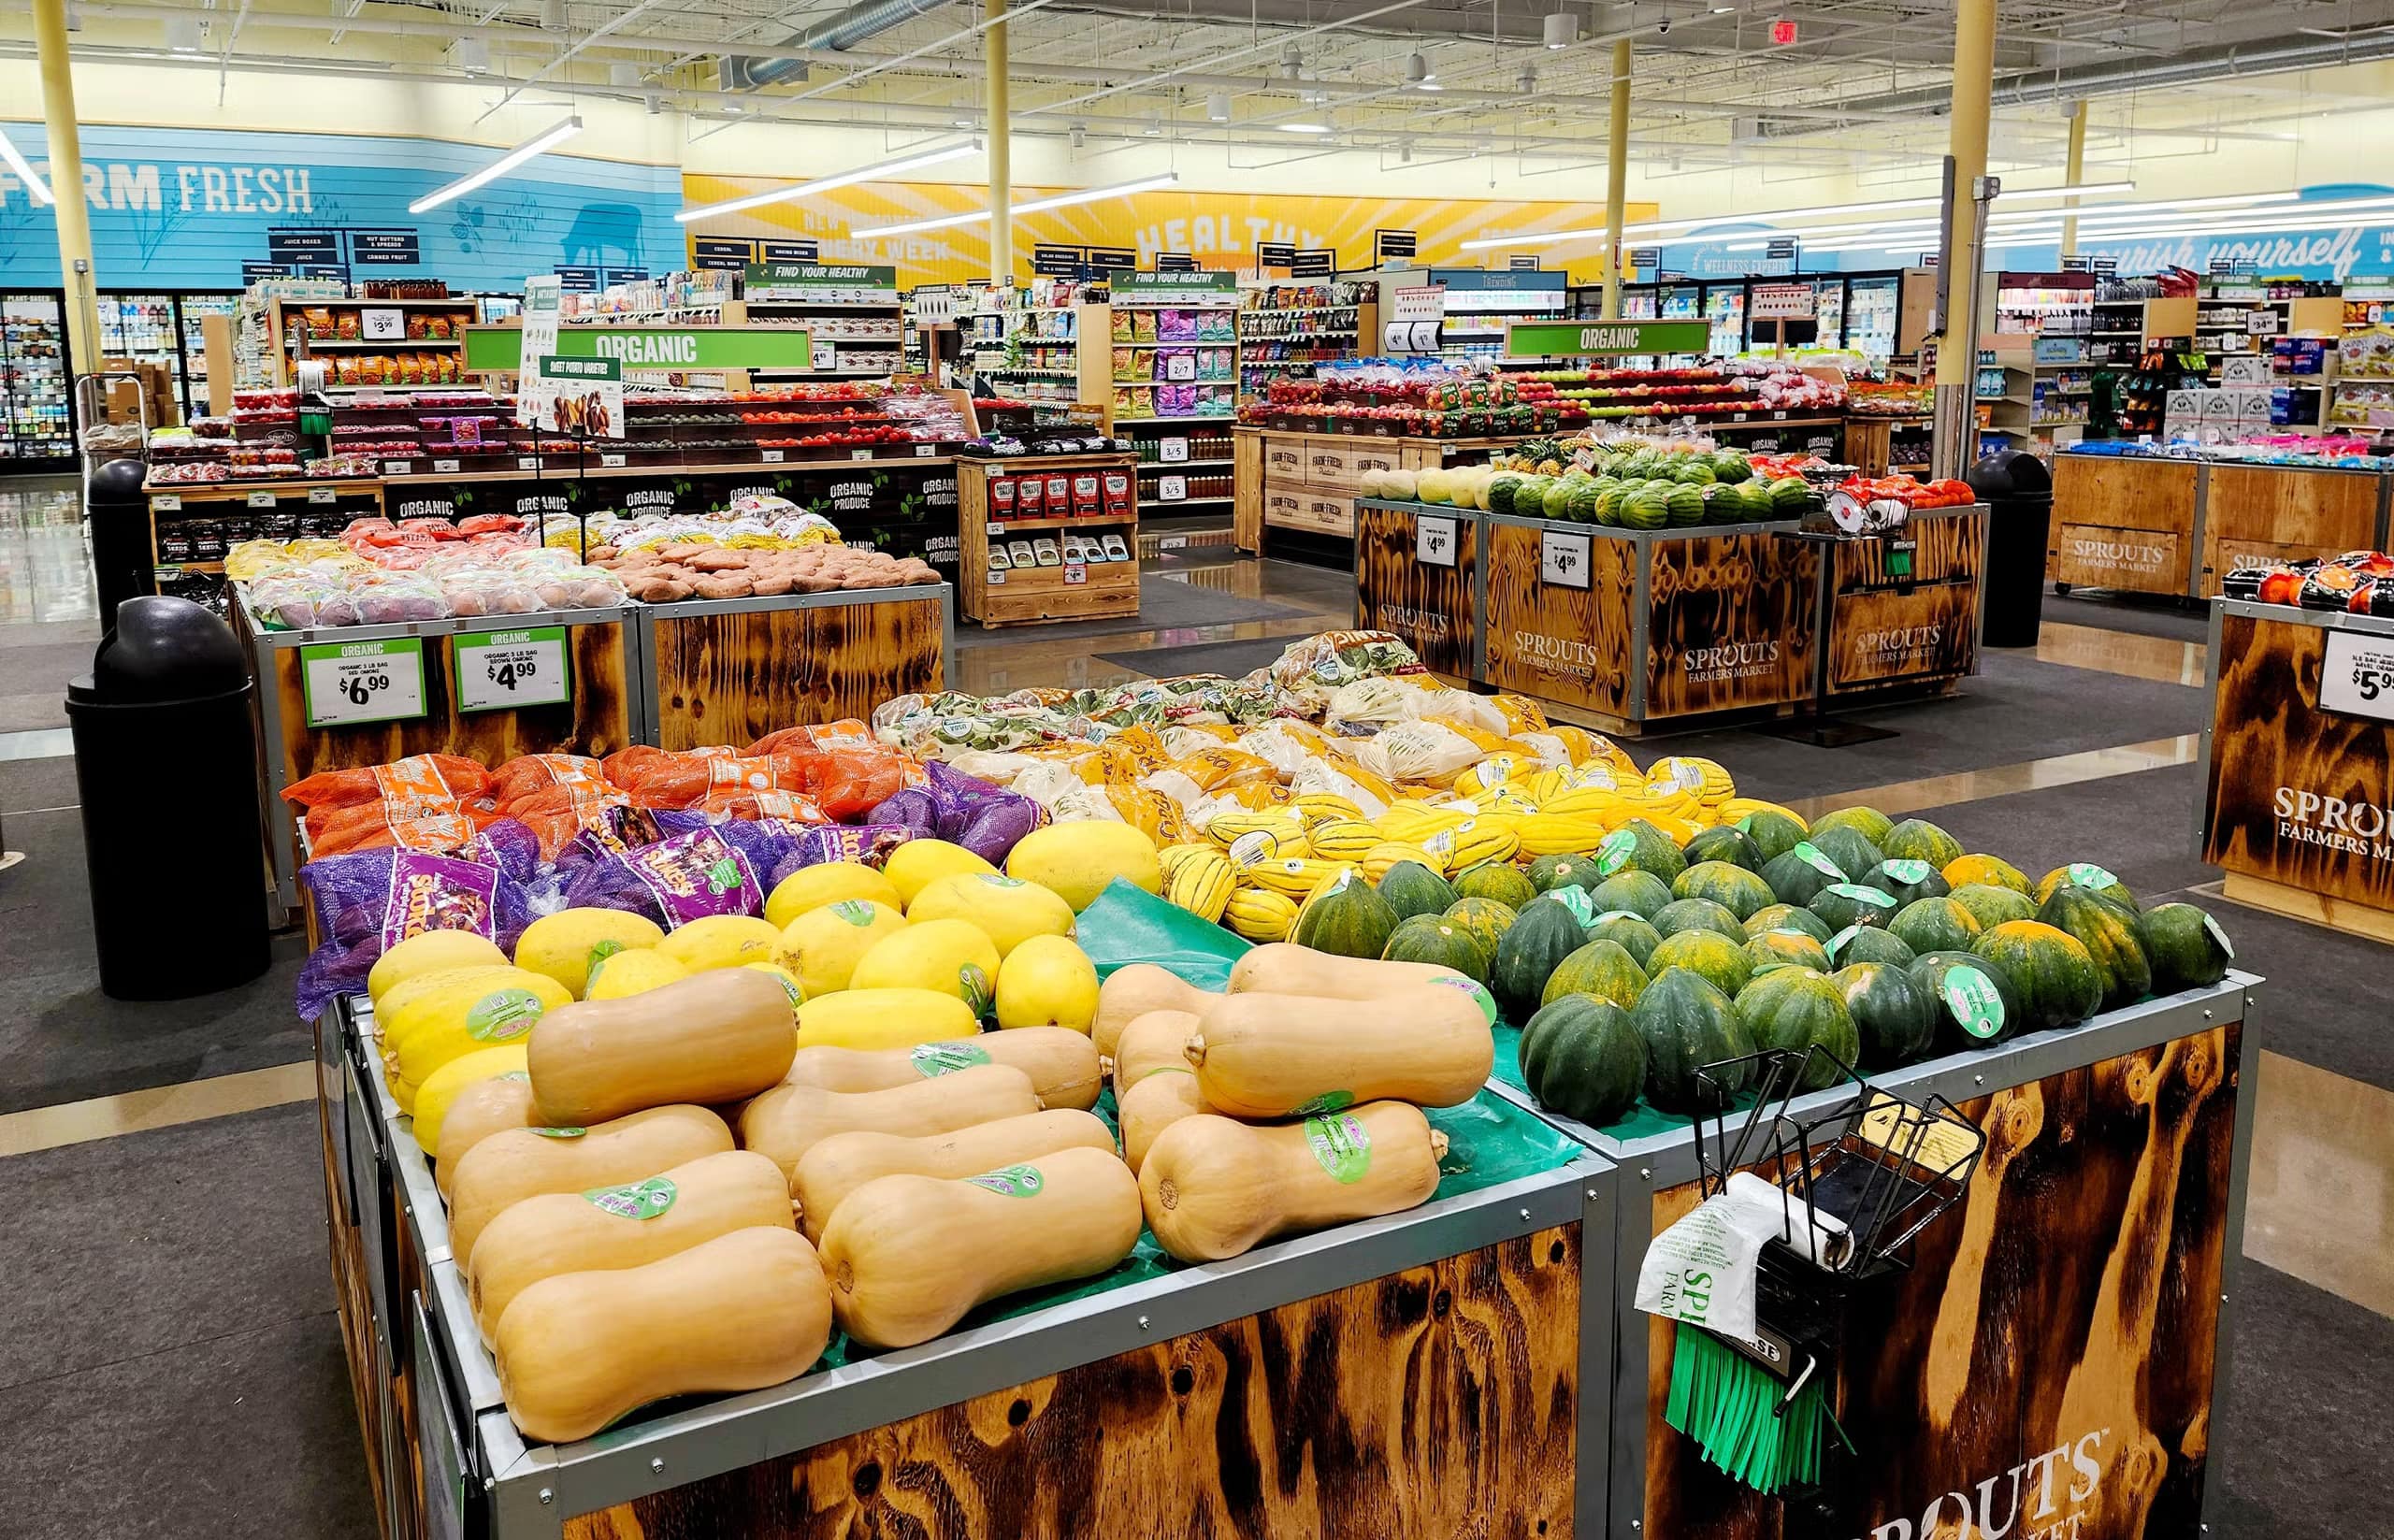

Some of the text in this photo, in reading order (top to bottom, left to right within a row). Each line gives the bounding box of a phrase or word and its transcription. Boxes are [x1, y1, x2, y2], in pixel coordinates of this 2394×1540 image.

[177, 166, 313, 214] FRESH
[887, 238, 950, 261] WEEK
[2078, 237, 2197, 273] urish
[774, 266, 870, 280] FIND YOUR HEALTHY
[1135, 272, 1155, 283] FIND
[1157, 273, 1178, 283] YOUR
[1179, 273, 1215, 284] HEALTHY
[1580, 327, 1640, 350] ORGANIC
[595, 335, 697, 363] ORGANIC
[550, 361, 609, 375] SWEET POTATO VARIETIES
[1174, 366, 1189, 374] 2/7
[1752, 439, 1779, 451] ORGANIC
[1807, 437, 1834, 449] ORGANIC
[1166, 447, 1181, 456] 3/5
[1272, 452, 1298, 466] FARM-FRESH
[1312, 455, 1343, 470] FARM-FRESH
[1357, 459, 1391, 472] FARM-FRESH
[830, 482, 873, 498] ORGANIC
[1165, 485, 1180, 495] 3/5
[516, 496, 569, 513] ORGANIC
[627, 490, 675, 507] ORGANIC
[834, 498, 871, 511] PRODUCE
[927, 493, 959, 506] PRODUC
[1271, 497, 1299, 511] FARM-FRESH
[399, 500, 454, 518] ORGANIC
[631, 507, 671, 521] PRODUCE
[1311, 502, 1342, 517] FARM-FRESH
[845, 540, 875, 554] GANIC
[1427, 536, 1446, 554] $499
[2074, 540, 2164, 563] SPROUTS
[1554, 554, 1577, 575] $499
[2077, 558, 2158, 573] FARMERS MARKET
[1380, 603, 1449, 634] SPROUTS
[491, 631, 530, 645] ORGANIC
[1854, 625, 1941, 655] SPROUTS
[341, 642, 384, 657] ORGANIC
[483, 652, 510, 660] ORGANIC
[1515, 630, 1598, 667] SPROUTS
[1683, 640, 1780, 671] SPROUTS
[338, 663, 363, 671] ORGANIC
[1518, 650, 1594, 677] FARMERS MARKET
[488, 662, 536, 691] $499
[1688, 663, 1775, 684] FARMERS MARKET
[339, 675, 390, 705] $699
[2352, 668, 2394, 701] $59
[2273, 786, 2394, 839] SPRO
[2279, 821, 2369, 856] FARMERS
